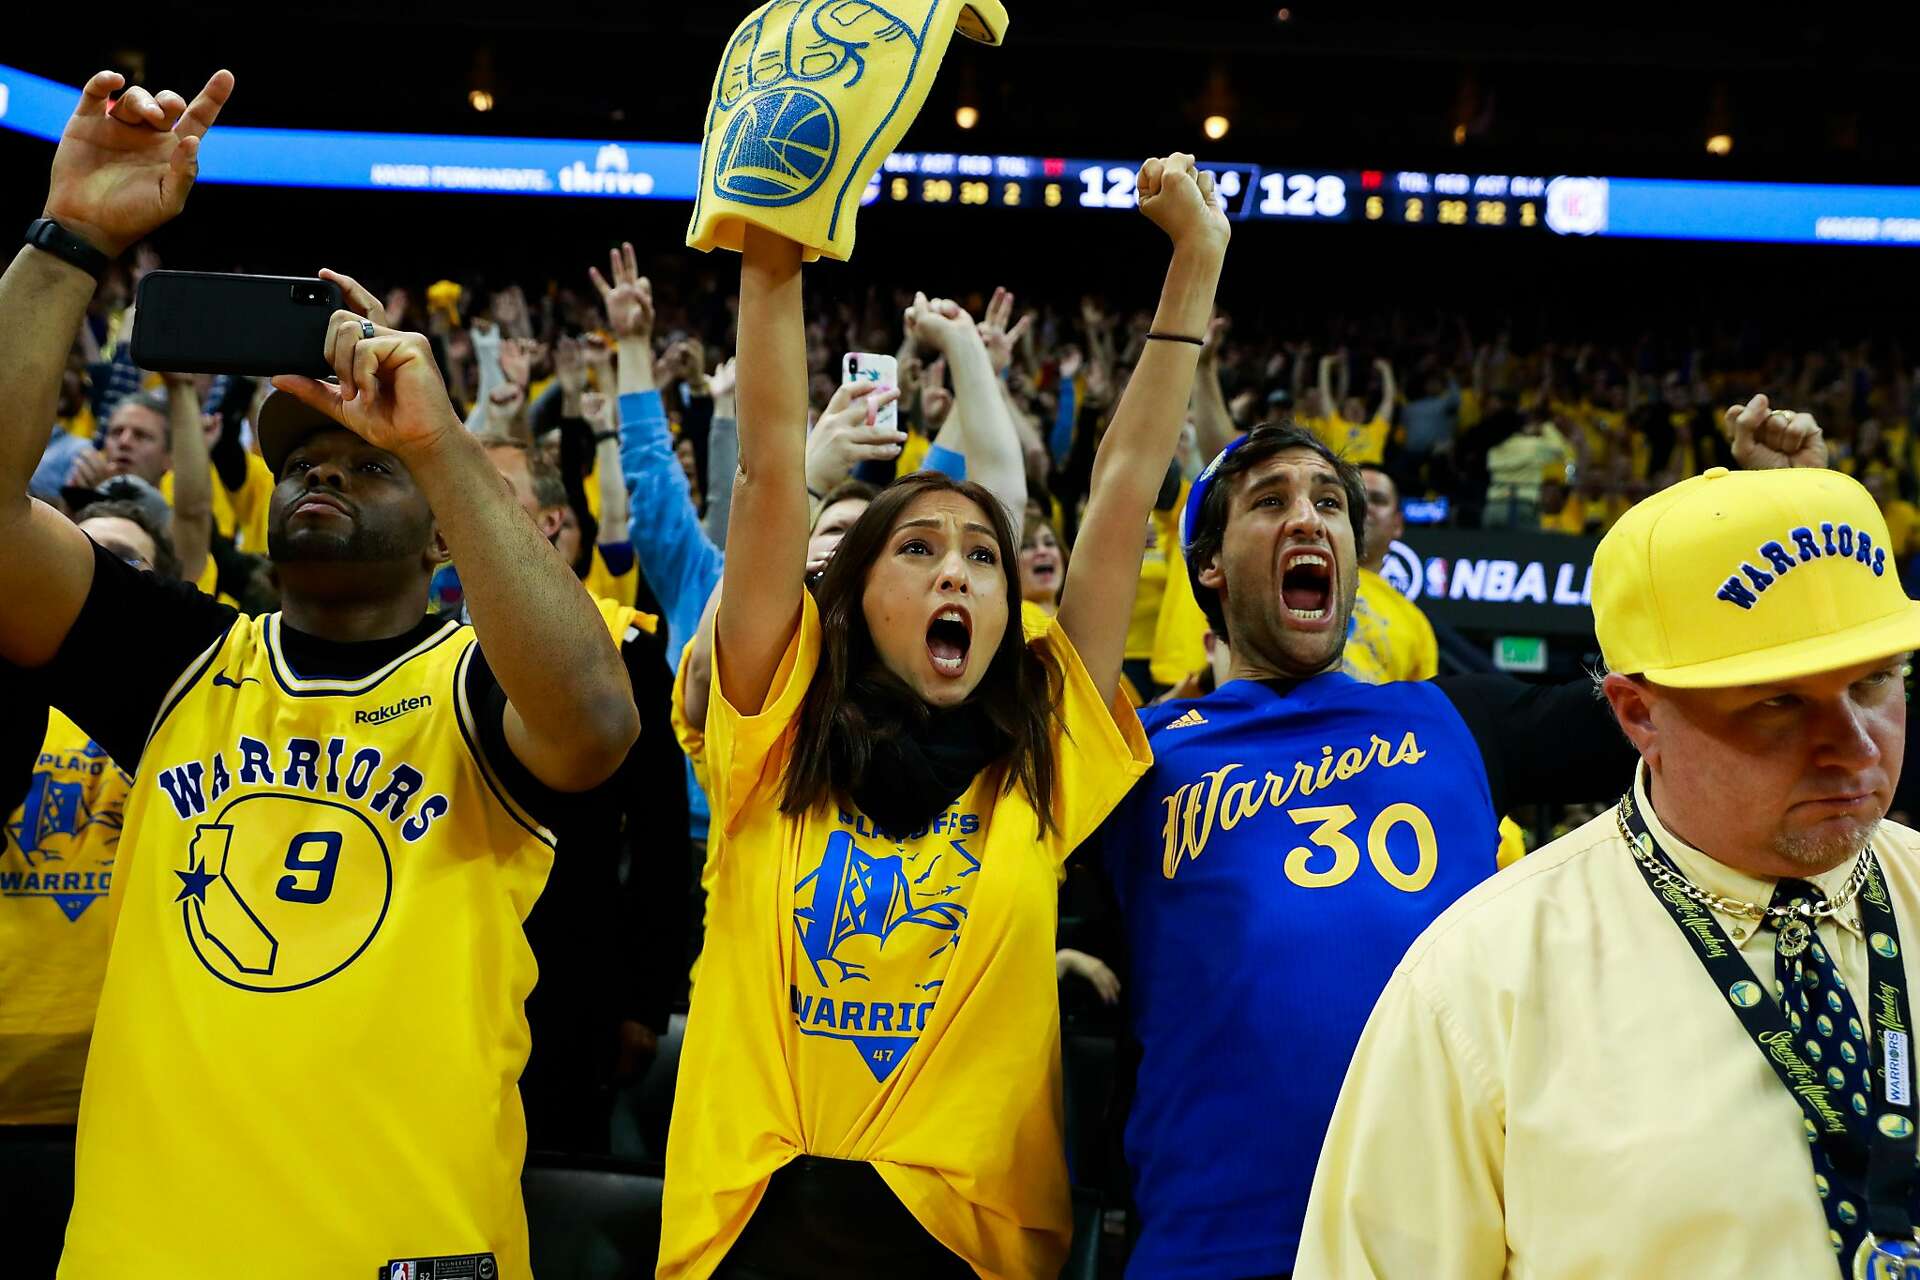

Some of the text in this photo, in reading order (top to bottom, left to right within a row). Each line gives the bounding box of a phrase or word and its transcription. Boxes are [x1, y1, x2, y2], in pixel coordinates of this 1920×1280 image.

[557, 161, 654, 195] thrive
[1079, 166, 1139, 209] 12
[1259, 172, 1347, 217] 128
[1450, 558, 1548, 604] NBA
[1716, 521, 1886, 611] WARRIORS
[355, 693, 432, 726] Rakuten
[158, 735, 450, 844] WARRIORS
[1161, 731, 1427, 880] Warriors
[275, 831, 344, 905] 9
[1283, 802, 1439, 893] 30
[872, 1049, 895, 1062] 47
[419, 1272, 430, 1280] 52
